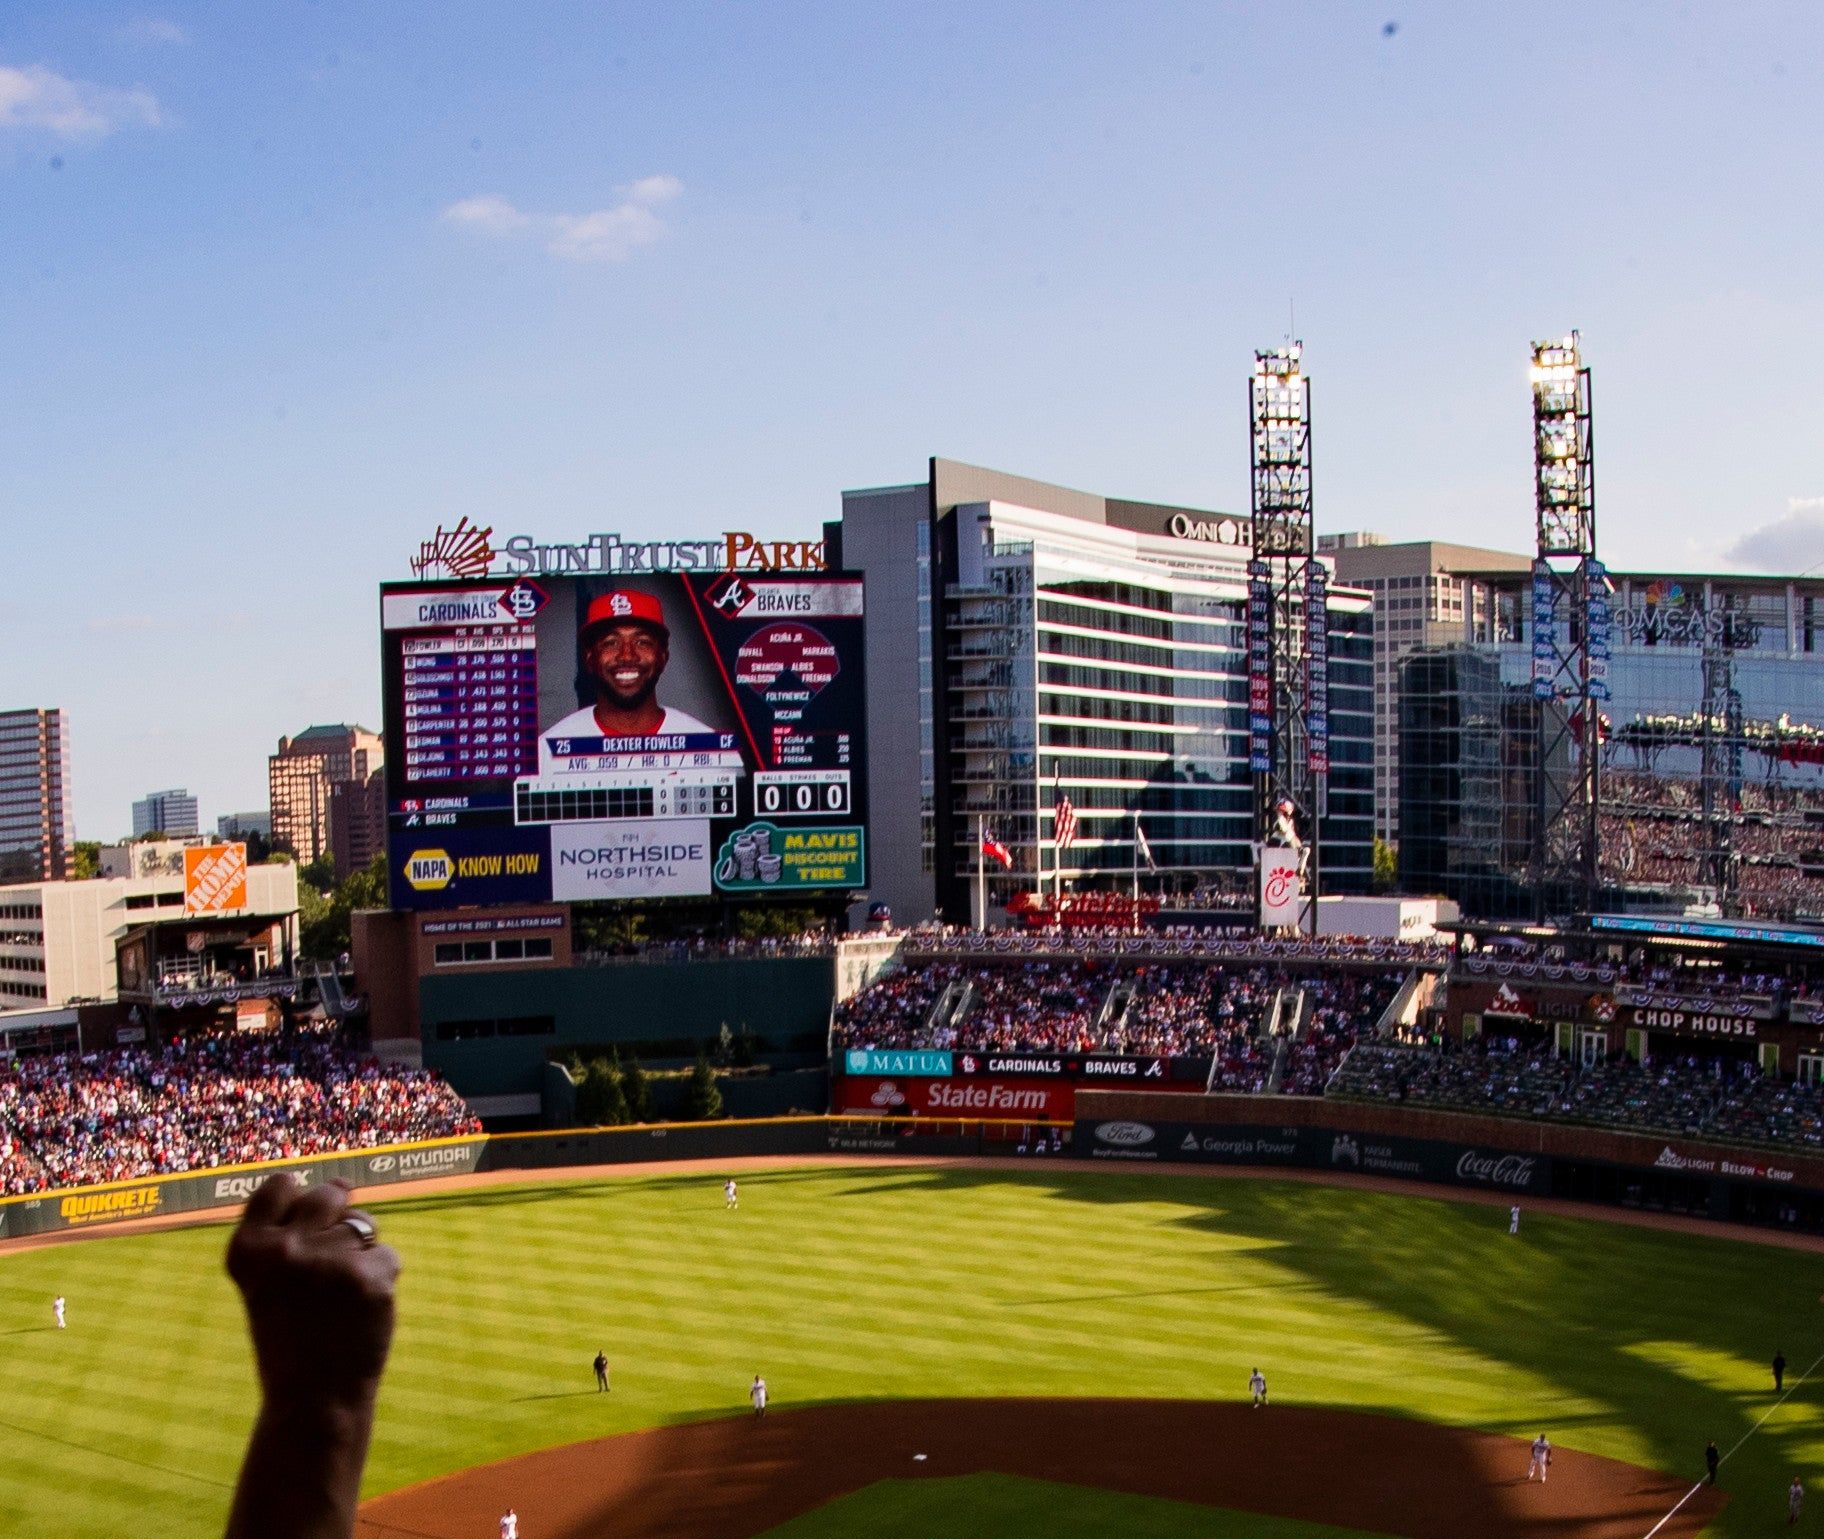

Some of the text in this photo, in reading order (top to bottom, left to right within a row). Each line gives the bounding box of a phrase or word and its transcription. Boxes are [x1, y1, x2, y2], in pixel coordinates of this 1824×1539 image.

[1171, 513, 1218, 543] OMNI
[722, 531, 828, 573] PARK
[757, 594, 811, 611] BRAVES
[419, 602, 497, 622] CARDINALS
[1614, 606, 1742, 635] OMCAST
[751, 662, 784, 671] SWANSON
[791, 661, 814, 671] ALBIES
[736, 674, 776, 684] DONALDSON
[802, 673, 832, 683] FREEMAN
[557, 735, 733, 753] 25 DEXTER FOWLER CF
[597, 756, 618, 769] .059
[663, 754, 670, 766] 0
[762, 774, 783, 782] BALLS
[790, 773, 817, 781] STRIKES
[425, 786, 727, 809] CARDINALS 0 0 0 0
[765, 785, 842, 810] 0 0 0
[426, 802, 727, 825] BRAVES 0 0 0 0
[784, 833, 858, 848] MAVIS
[560, 844, 703, 866] NORTHSIDE
[784, 851, 858, 865] DISCOUNT
[192, 854, 217, 880] THE
[412, 859, 448, 880] NAPA
[458, 854, 539, 877] KNOW HOW
[586, 866, 678, 880] HOSPITAL
[798, 867, 846, 880] TIRE
[186, 846, 246, 911] HOME
[208, 867, 246, 911] DEPOT
[458, 922, 473, 930] THE
[540, 917, 562, 926] GAME
[1539, 1003, 1583, 1018] LIGHT
[1633, 1009, 1757, 1036] CHOP HOUSE
[876, 1055, 948, 1071] MATUA
[988, 1059, 1137, 1075] CARDINALS BRAVES
[1104, 1123, 1144, 1141] Ford
[858, 1140, 897, 1149] NETWORK
[1203, 1138, 1295, 1154] Georgia Power
[1365, 1146, 1392, 1156] KAISER
[399, 1147, 471, 1168] HYUNDAI
[1364, 1158, 1420, 1173] PERMANENTE
[1456, 1150, 1537, 1186] Coca-Cola
[1688, 1159, 1715, 1172] LIGHT
[1721, 1161, 1755, 1175] BELOW
[1766, 1167, 1794, 1181] CHOP
[215, 1169, 313, 1199] EQUX
[60, 1187, 160, 1219] QUIKRETE
